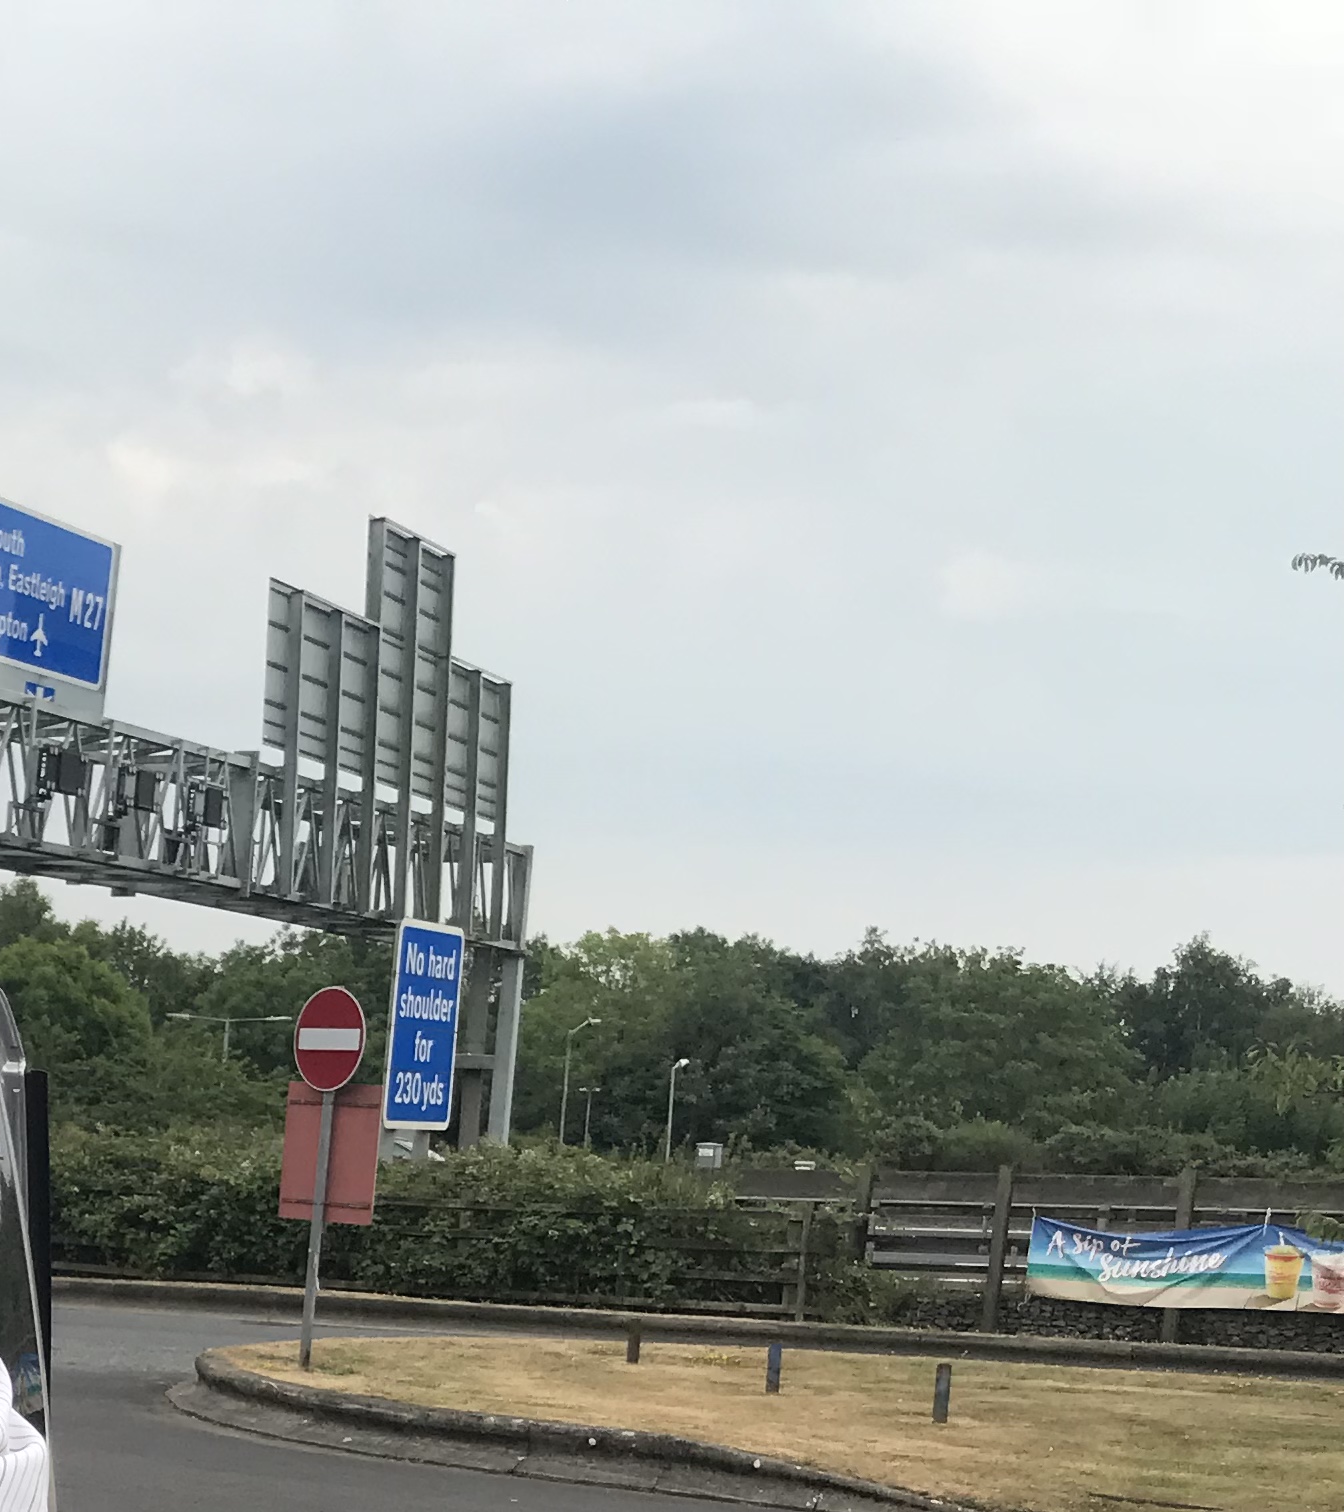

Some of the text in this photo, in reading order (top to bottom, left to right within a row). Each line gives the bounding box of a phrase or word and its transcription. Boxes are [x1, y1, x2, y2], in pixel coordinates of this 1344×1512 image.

[7, 564, 66, 609] Eastleigh
[405, 941, 457, 981] No hard
[399, 986, 455, 1023] shoulder
[414, 1031, 433, 1062] for
[1046, 1230, 1142, 1263] A Sip of
[1098, 1246, 1228, 1283] Sunshine
